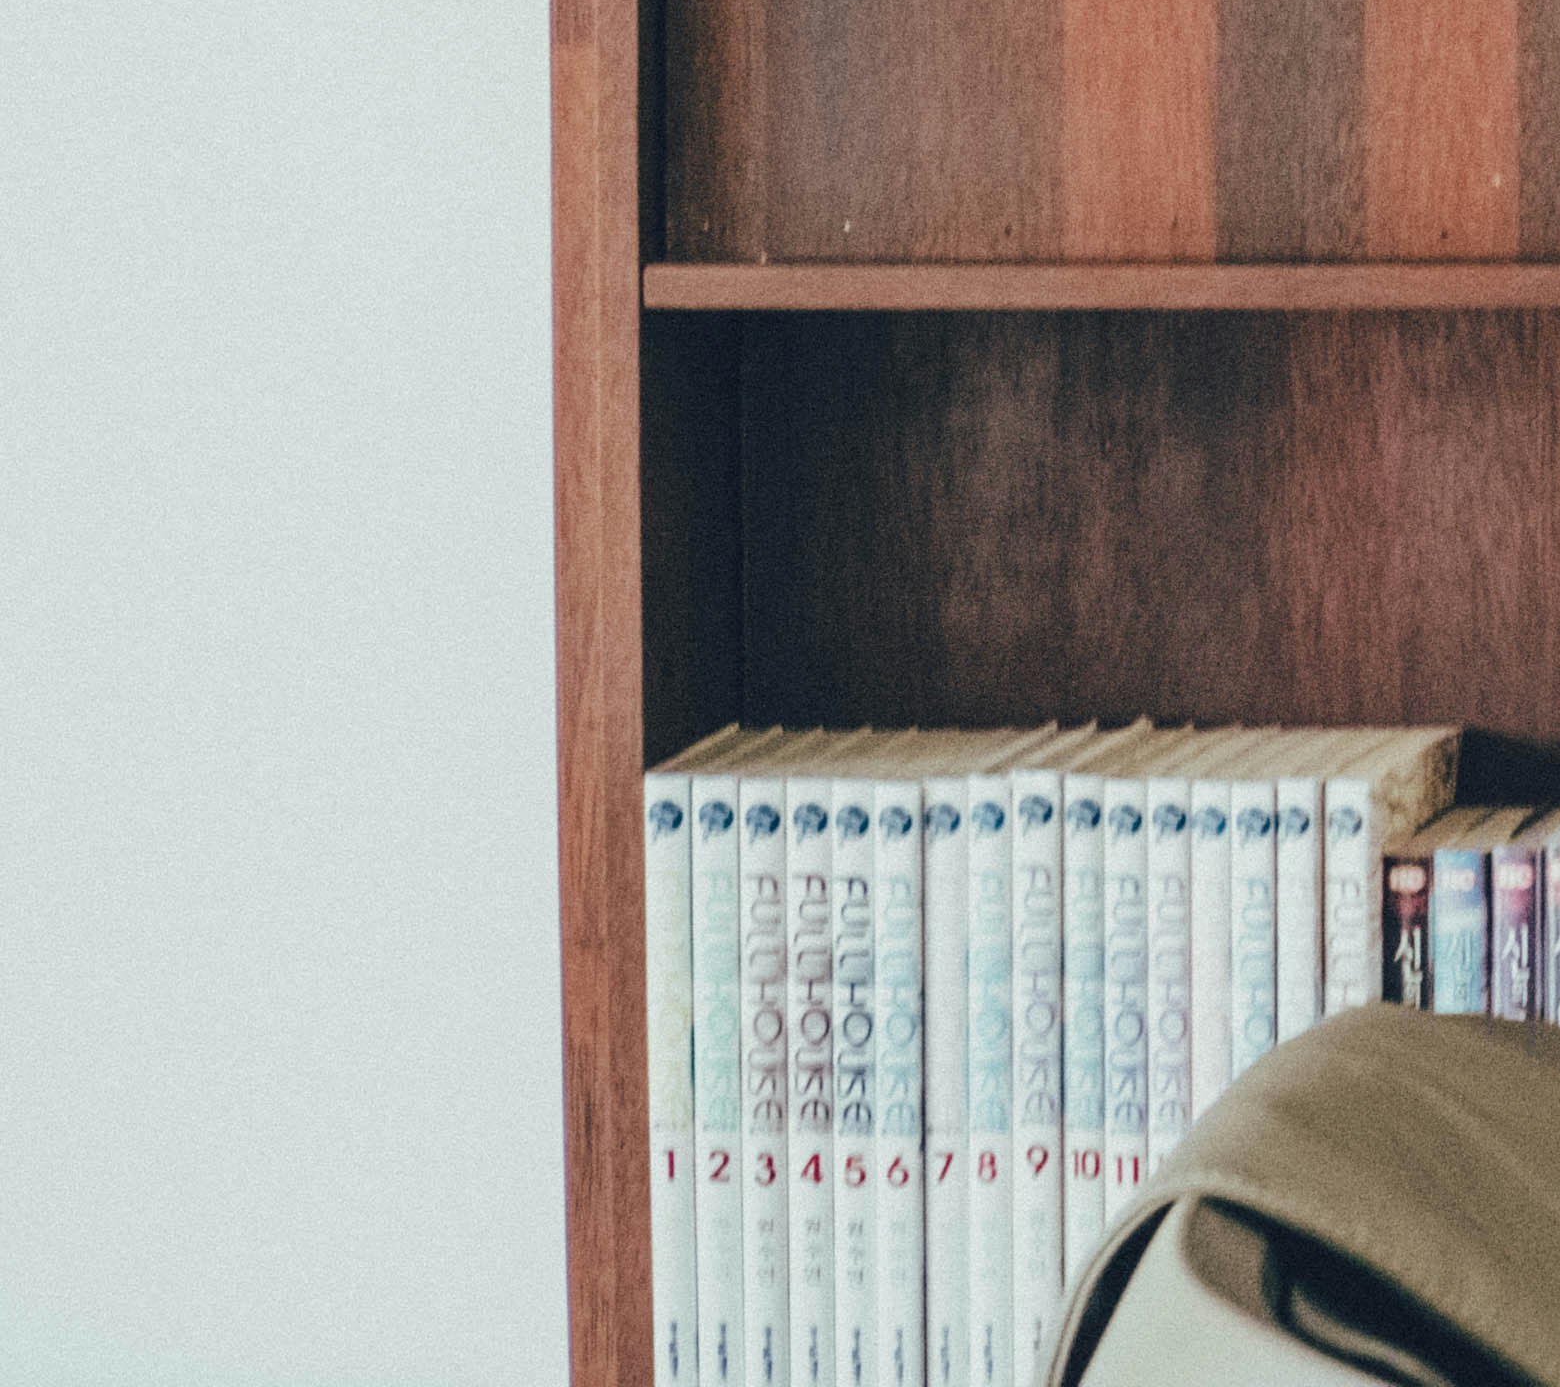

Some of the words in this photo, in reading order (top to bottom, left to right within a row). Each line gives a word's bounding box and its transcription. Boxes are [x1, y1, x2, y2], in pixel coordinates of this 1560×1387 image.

[666, 1149, 675, 1182] 1
[708, 1151, 731, 1183] 2
[755, 1152, 777, 1187] 3
[801, 1151, 824, 1184] 4
[844, 1154, 867, 1187] 5
[886, 1154, 910, 1187] 6
[936, 1151, 956, 1183] 7
[977, 1151, 998, 1183] 8
[1026, 1146, 1050, 1177] 9
[1073, 1148, 1101, 1181] 10
[1117, 1154, 1141, 1186] 11
